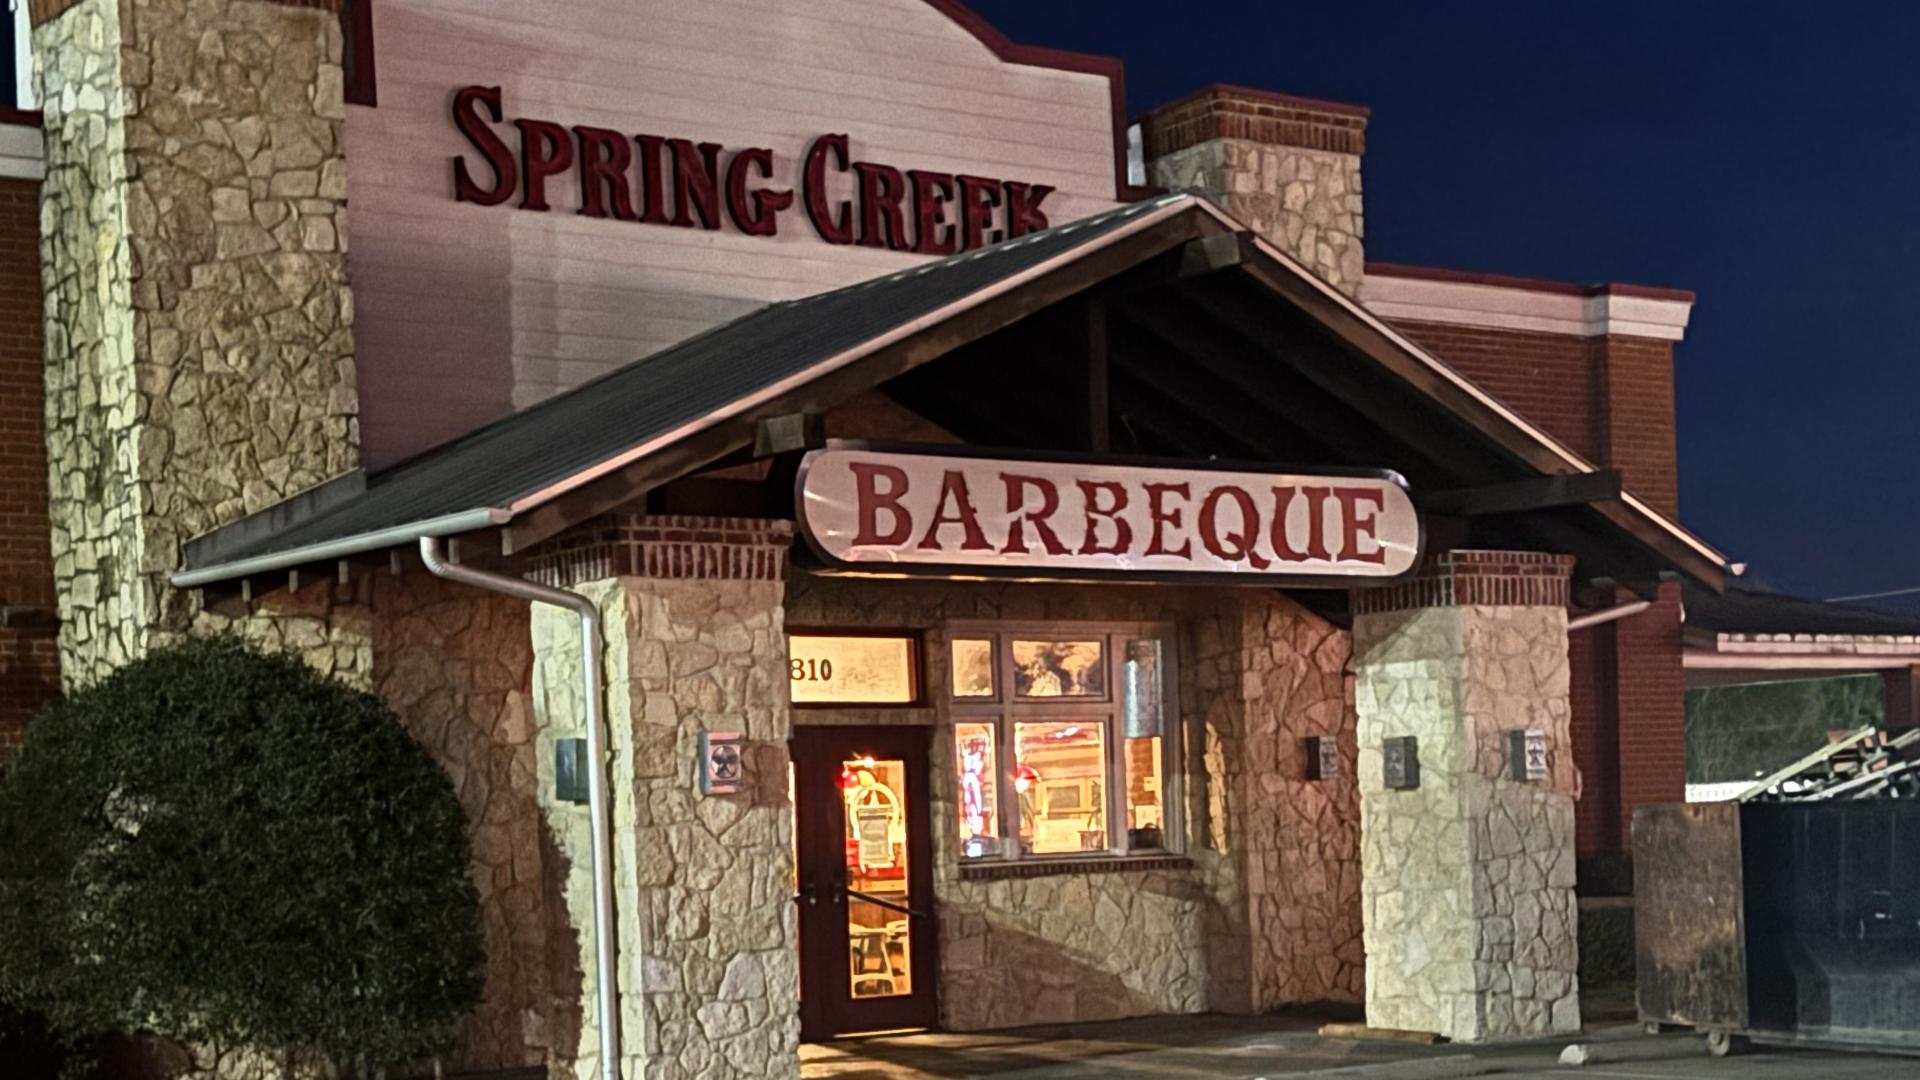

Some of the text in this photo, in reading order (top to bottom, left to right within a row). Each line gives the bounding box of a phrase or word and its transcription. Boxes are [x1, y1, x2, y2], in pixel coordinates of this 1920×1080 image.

[452, 85, 1056, 254] SPRING CREEK
[849, 461, 1387, 570] BARBEQUE
[790, 658, 832, 681] 810
